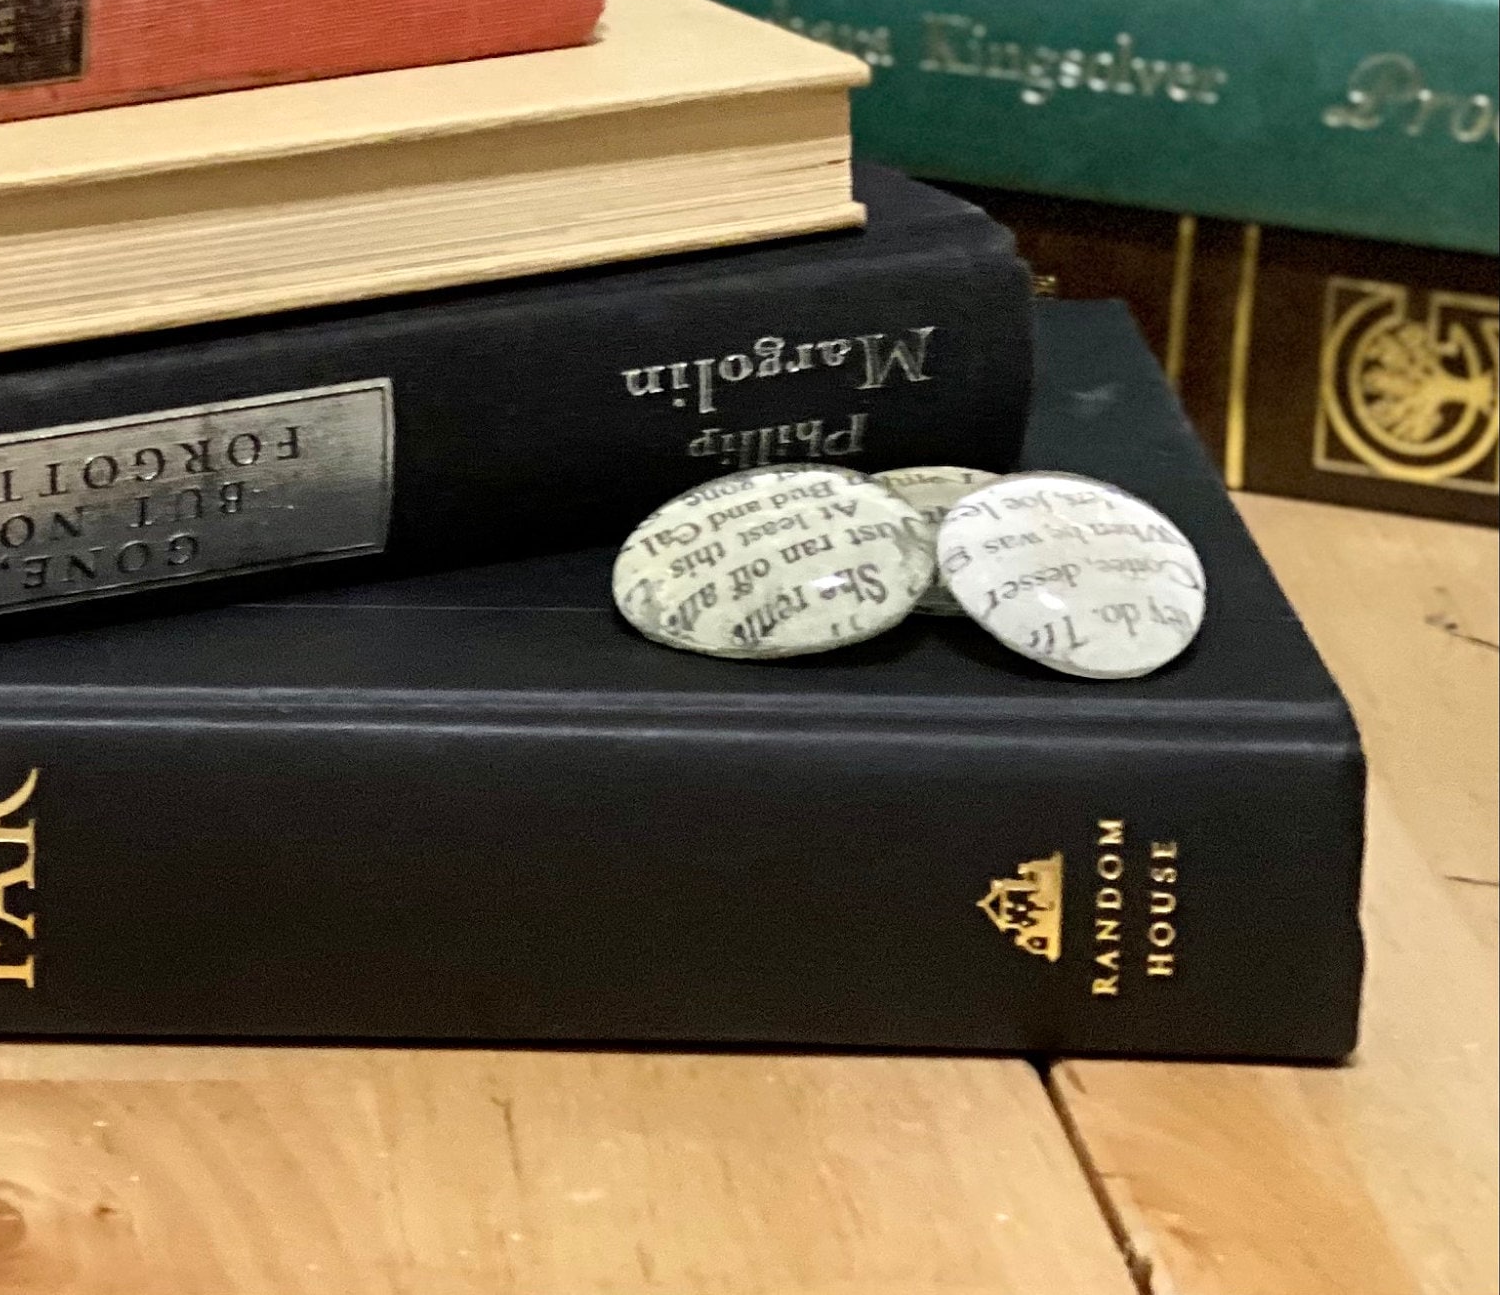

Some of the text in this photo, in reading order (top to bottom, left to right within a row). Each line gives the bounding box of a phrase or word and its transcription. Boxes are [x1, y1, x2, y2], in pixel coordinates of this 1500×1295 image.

[919, 12, 1229, 105] Kingsolver
[1323, 54, 1499, 142] Pro
[621, 326, 938, 414] Margolin
[688, 412, 869, 469] Phillip
[130, 480, 246, 529] BUT
[707, 500, 762, 532] and
[770, 480, 837, 509] Bud
[0, 533, 199, 590] GONE,
[669, 499, 858, 579] At least this
[780, 534, 833, 564] ran
[984, 532, 1043, 554] was
[820, 563, 888, 606] She
[1092, 819, 1125, 996] RANDOM
[1147, 841, 1178, 977] HOUSE
